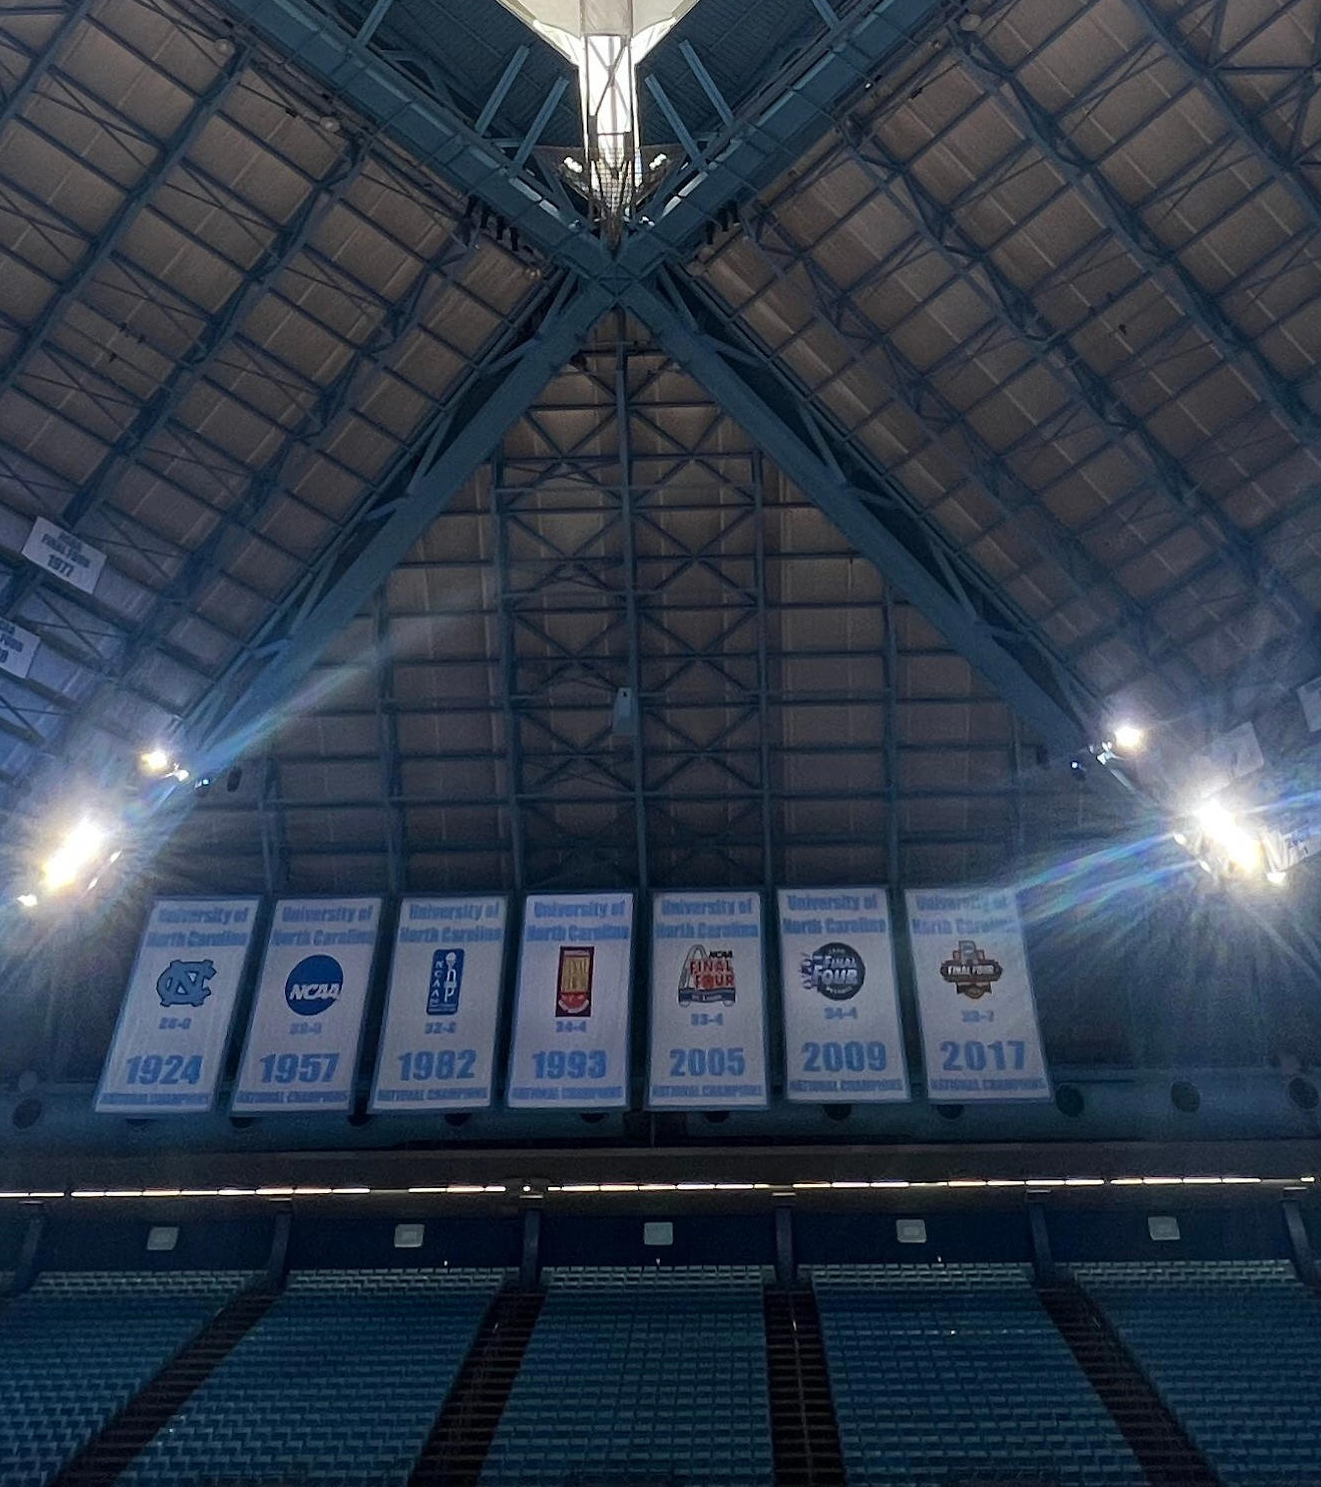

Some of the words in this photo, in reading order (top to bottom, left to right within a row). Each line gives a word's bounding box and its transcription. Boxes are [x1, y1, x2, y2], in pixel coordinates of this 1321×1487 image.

[48, 554, 74, 577] 1977
[281, 905, 358, 922] University
[359, 904, 376, 920] of
[409, 903, 481, 921] University
[483, 902, 497, 918] of
[533, 900, 605, 918] University
[607, 899, 627, 916] of
[662, 899, 739, 917] University
[739, 898, 753, 915] of
[788, 895, 861, 914] University
[862, 894, 879, 912] of
[398, 925, 439, 943] North
[439, 925, 503, 942] Carolina
[525, 924, 567, 943] North
[567, 924, 630, 942] Carolina
[657, 921, 697, 938] North
[696, 921, 760, 938] Carolina
[782, 918, 825, 935] North
[824, 917, 888, 934] Carolina
[689, 959, 733, 974] FINAL
[823, 954, 857, 968] FINAL
[947, 964, 972, 975] FINAL
[693, 973, 736, 988] FOUR
[813, 965, 858, 984] FOUR
[289, 981, 341, 1001] NCAA
[669, 1046, 747, 1077] 2005
[801, 1040, 888, 1073] 2009
[939, 1039, 1027, 1071] 2017
[125, 1054, 203, 1085] 1924
[258, 1053, 340, 1084] 1957
[398, 1050, 477, 1081] 1982
[532, 1050, 609, 1080] 1993
